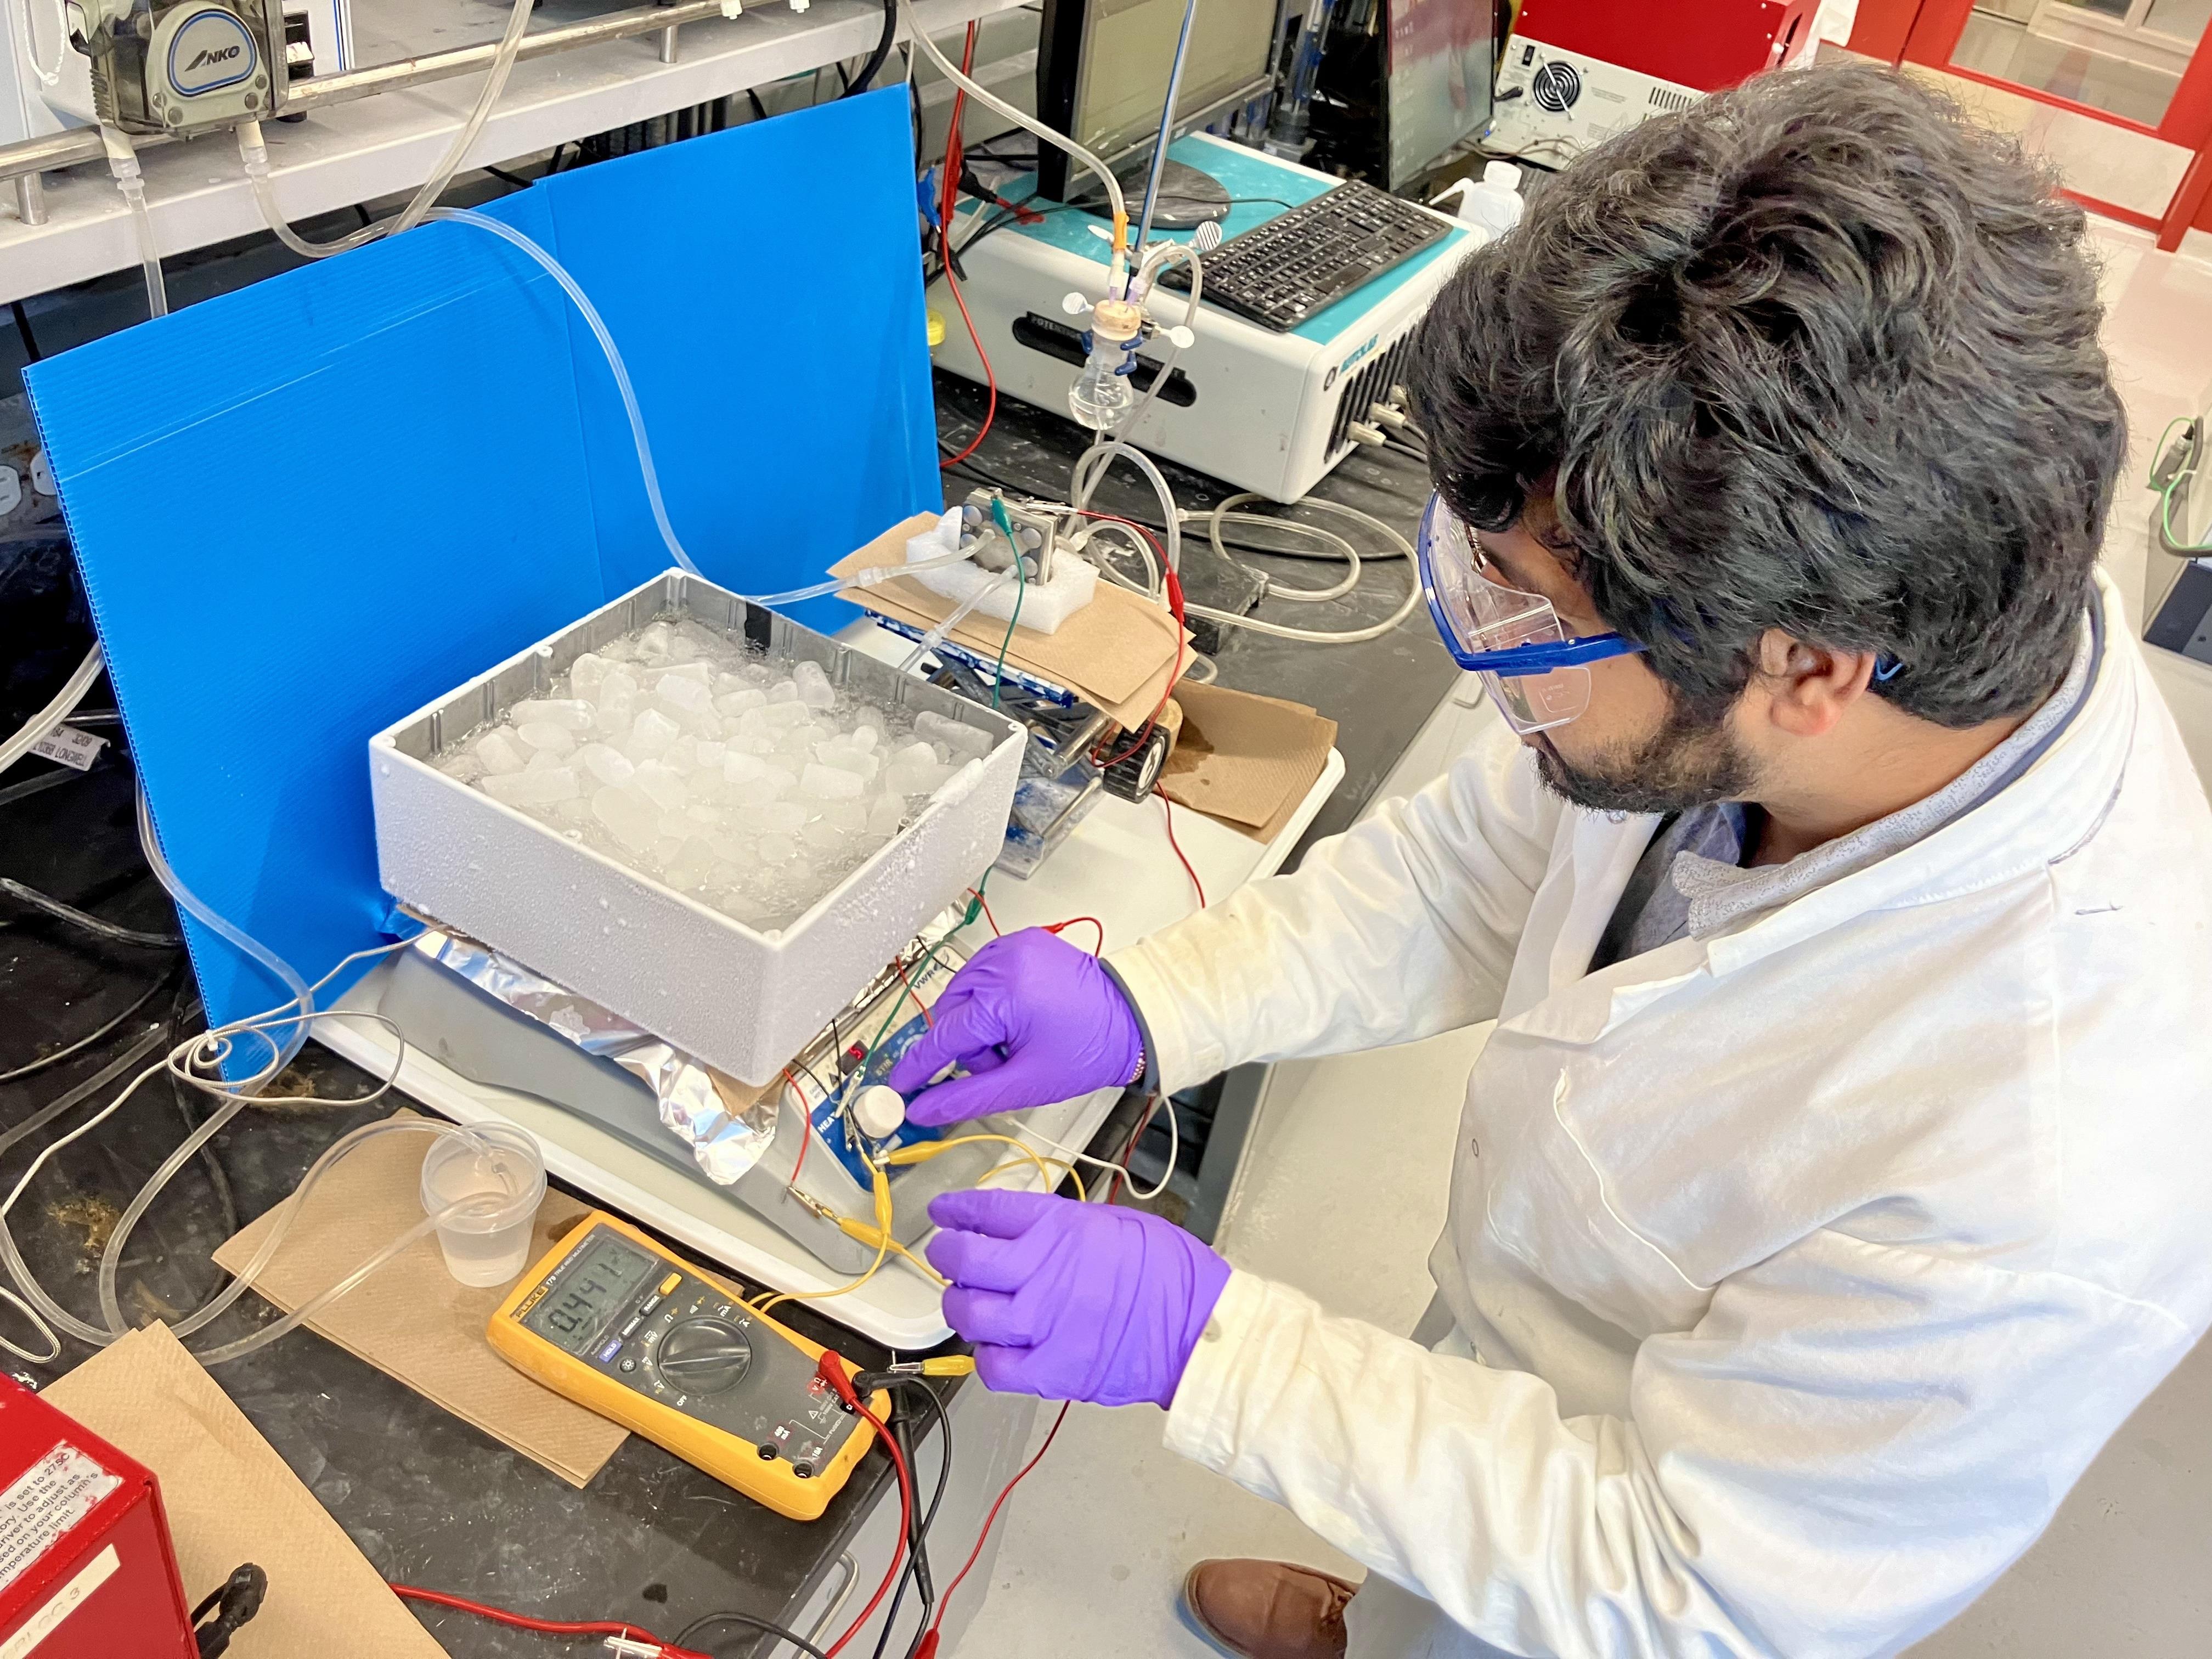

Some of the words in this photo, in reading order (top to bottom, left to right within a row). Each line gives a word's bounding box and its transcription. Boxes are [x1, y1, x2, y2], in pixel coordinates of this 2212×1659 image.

[913, 970, 935, 989] VWR
[516, 1286, 546, 1318] FLUKE
[644, 1295, 660, 1311] RANGE
[603, 1342, 617, 1357] HOLD
[676, 1395, 687, 1406] OFF
[4, 1501, 16, 1510] is
[17, 1485, 34, 1500] set
[33, 1476, 44, 1486] to
[44, 1453, 70, 1475] 275C
[18, 1495, 40, 1513] Use
[39, 1480, 57, 1495] the
[17, 1533, 30, 1545] on
[31, 1511, 53, 1534] your
[54, 1472, 99, 1512] column's
[24, 1513, 36, 1522] to
[36, 1485, 67, 1513] adjust
[67, 1474, 81, 1486] as
[0, 1530, 50, 1579] mperature
[49, 1509, 75, 1530] limit
